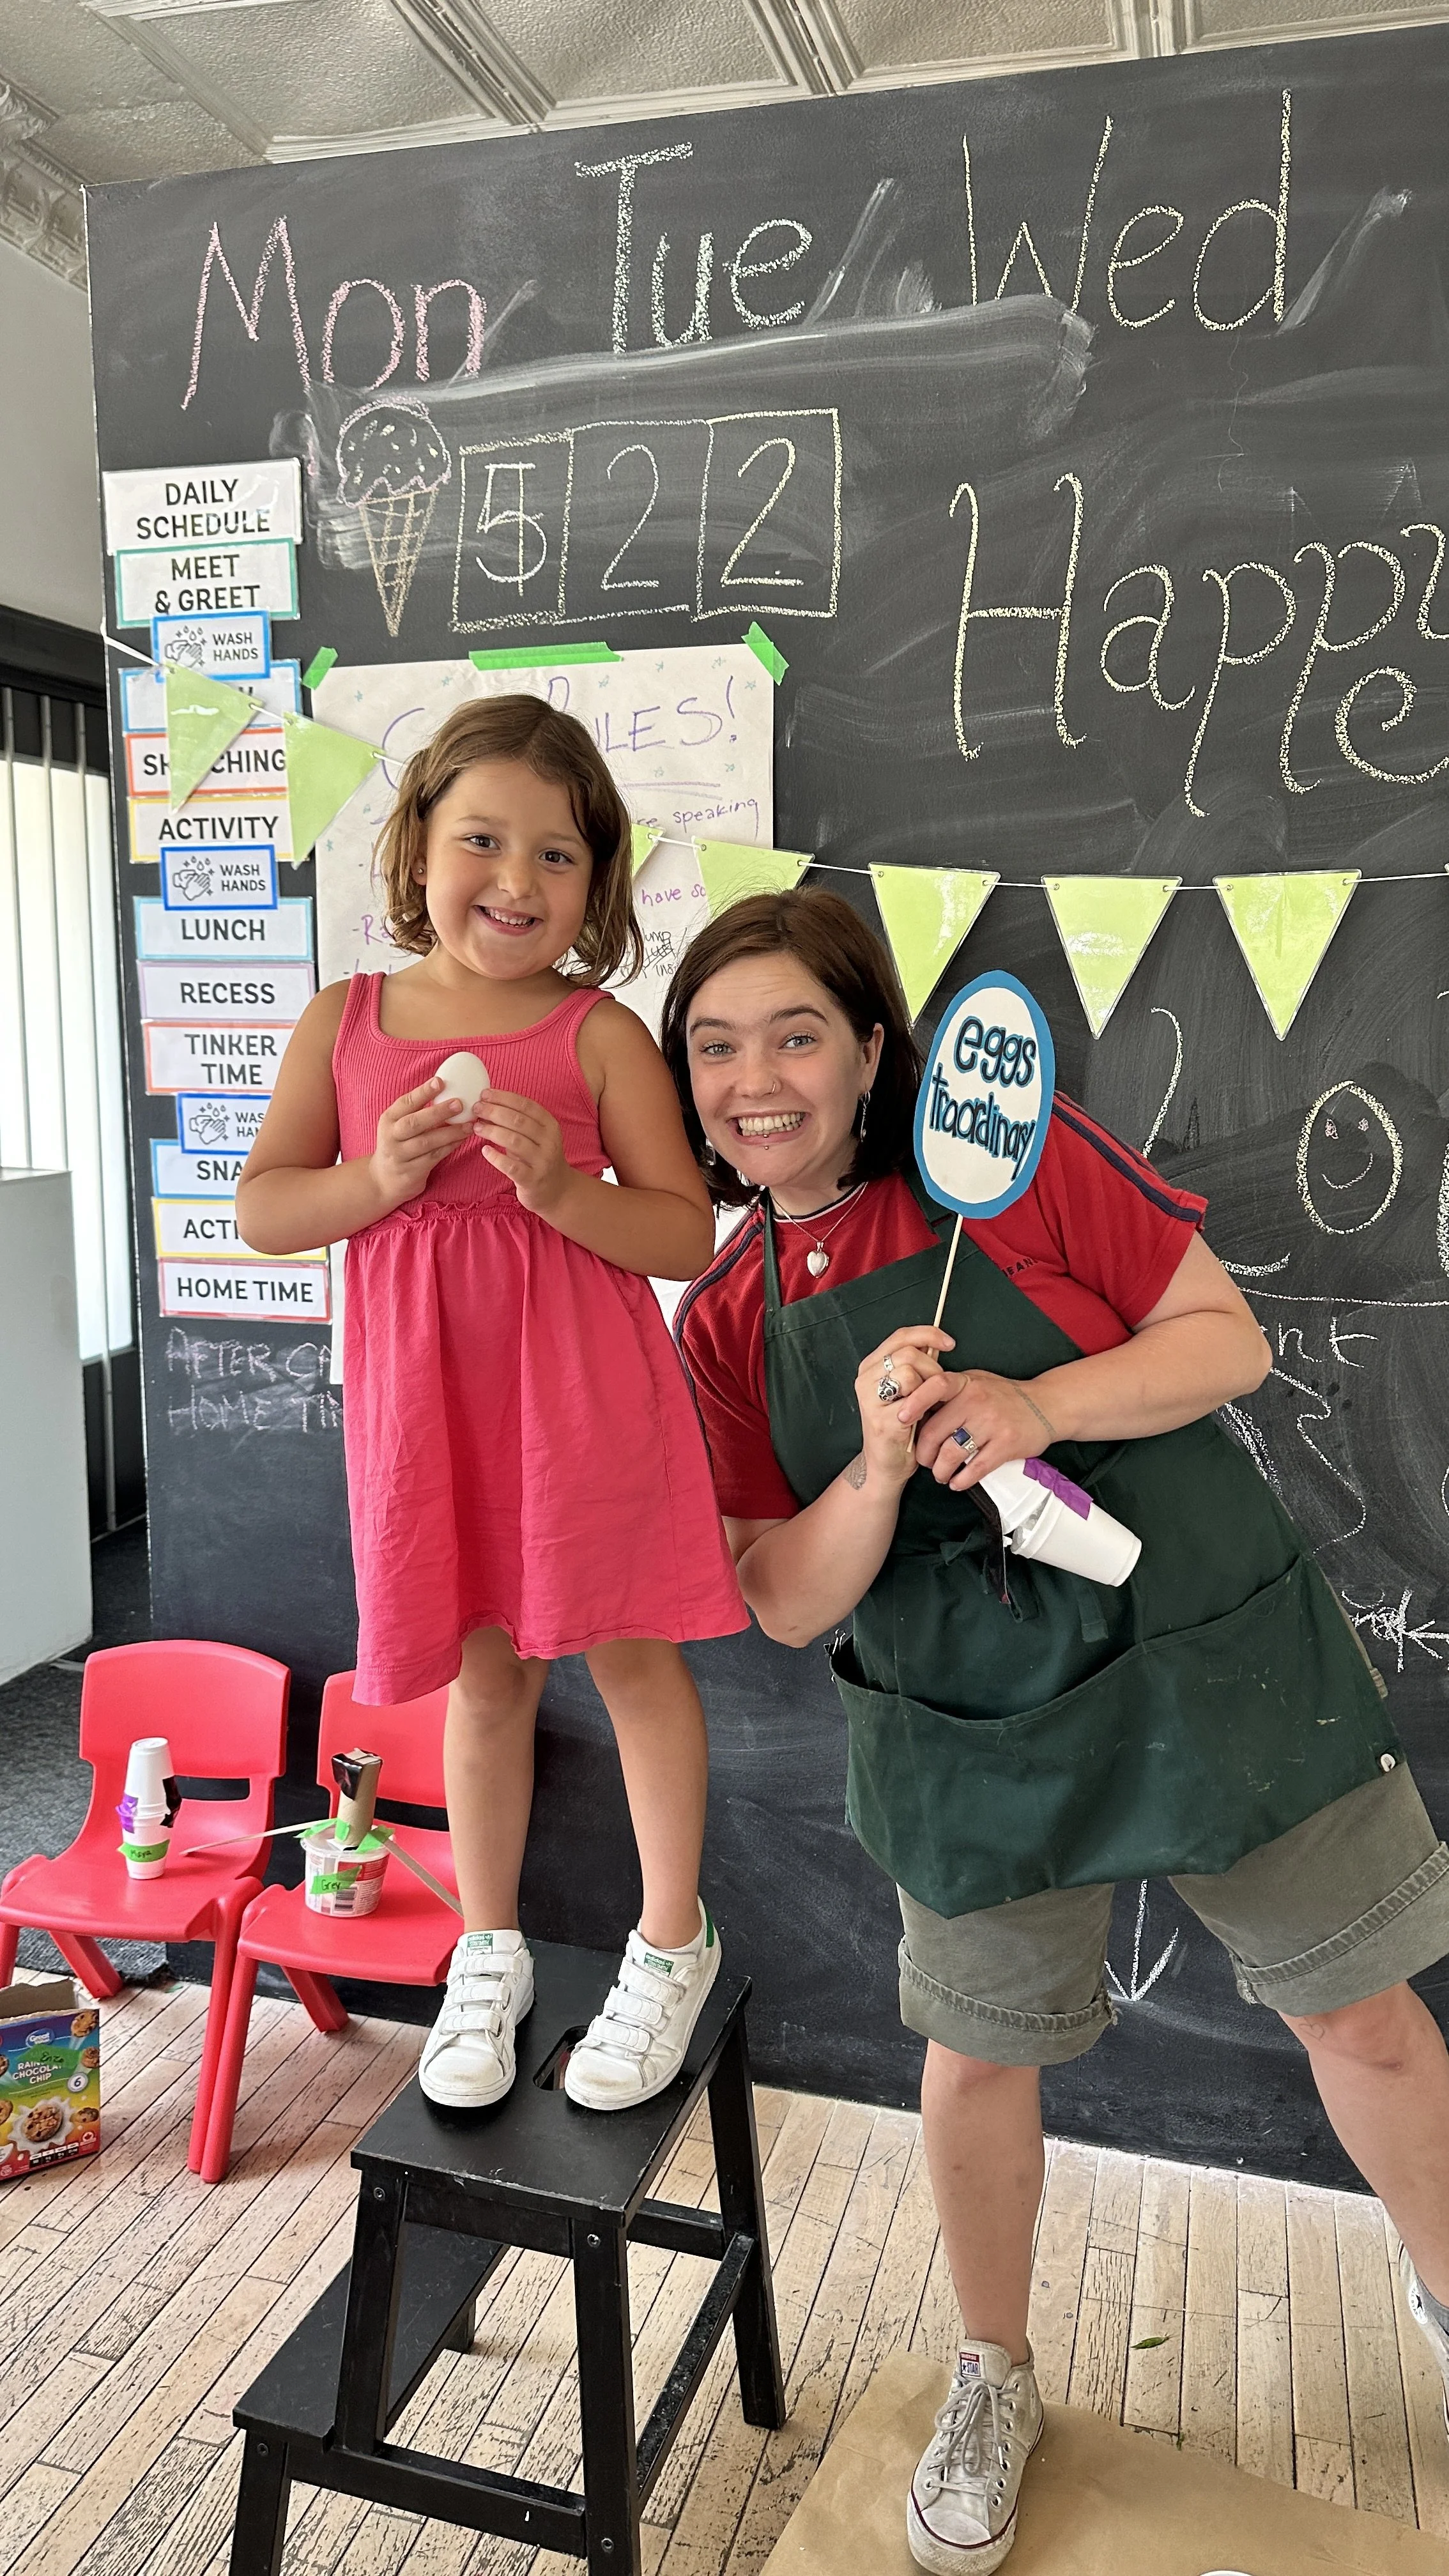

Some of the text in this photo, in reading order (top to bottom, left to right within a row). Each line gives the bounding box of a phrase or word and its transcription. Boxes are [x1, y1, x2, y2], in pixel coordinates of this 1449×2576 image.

[963, 88, 1292, 331] Wed
[575, 142, 813, 353] Tue
[181, 215, 487, 410] Mon
[165, 479, 238, 505] DAILY
[137, 509, 270, 540] SCHEDULE
[171, 555, 240, 580] MEET
[155, 585, 261, 613] & GREET
[212, 632, 252, 645] WASH
[213, 648, 259, 661] HANDS
[158, 816, 279, 840] ACTIVITY
[673, 799, 759, 841] speaking
[220, 864, 260, 877] WASH
[221, 879, 266, 892] HANDS
[641, 888, 681, 907] have
[181, 919, 266, 941] LUNCH
[180, 982, 275, 1004] RECESS
[184, 1034, 277, 1057] TINKER
[954, 1016, 1036, 1087] eggs
[201, 1063, 263, 1085] TIME
[235, 1112, 264, 1123] WAS
[196, 1160, 243, 1181] SNA
[183, 1219, 239, 1240] ACTI
[177, 1278, 314, 1303] HOME TIME
[165, 1326, 277, 1383] AFTER
[167, 1384, 272, 1431] HOME
[29, 2073, 52, 2084] CHIP
[74, 2076, 81, 2087] 6
